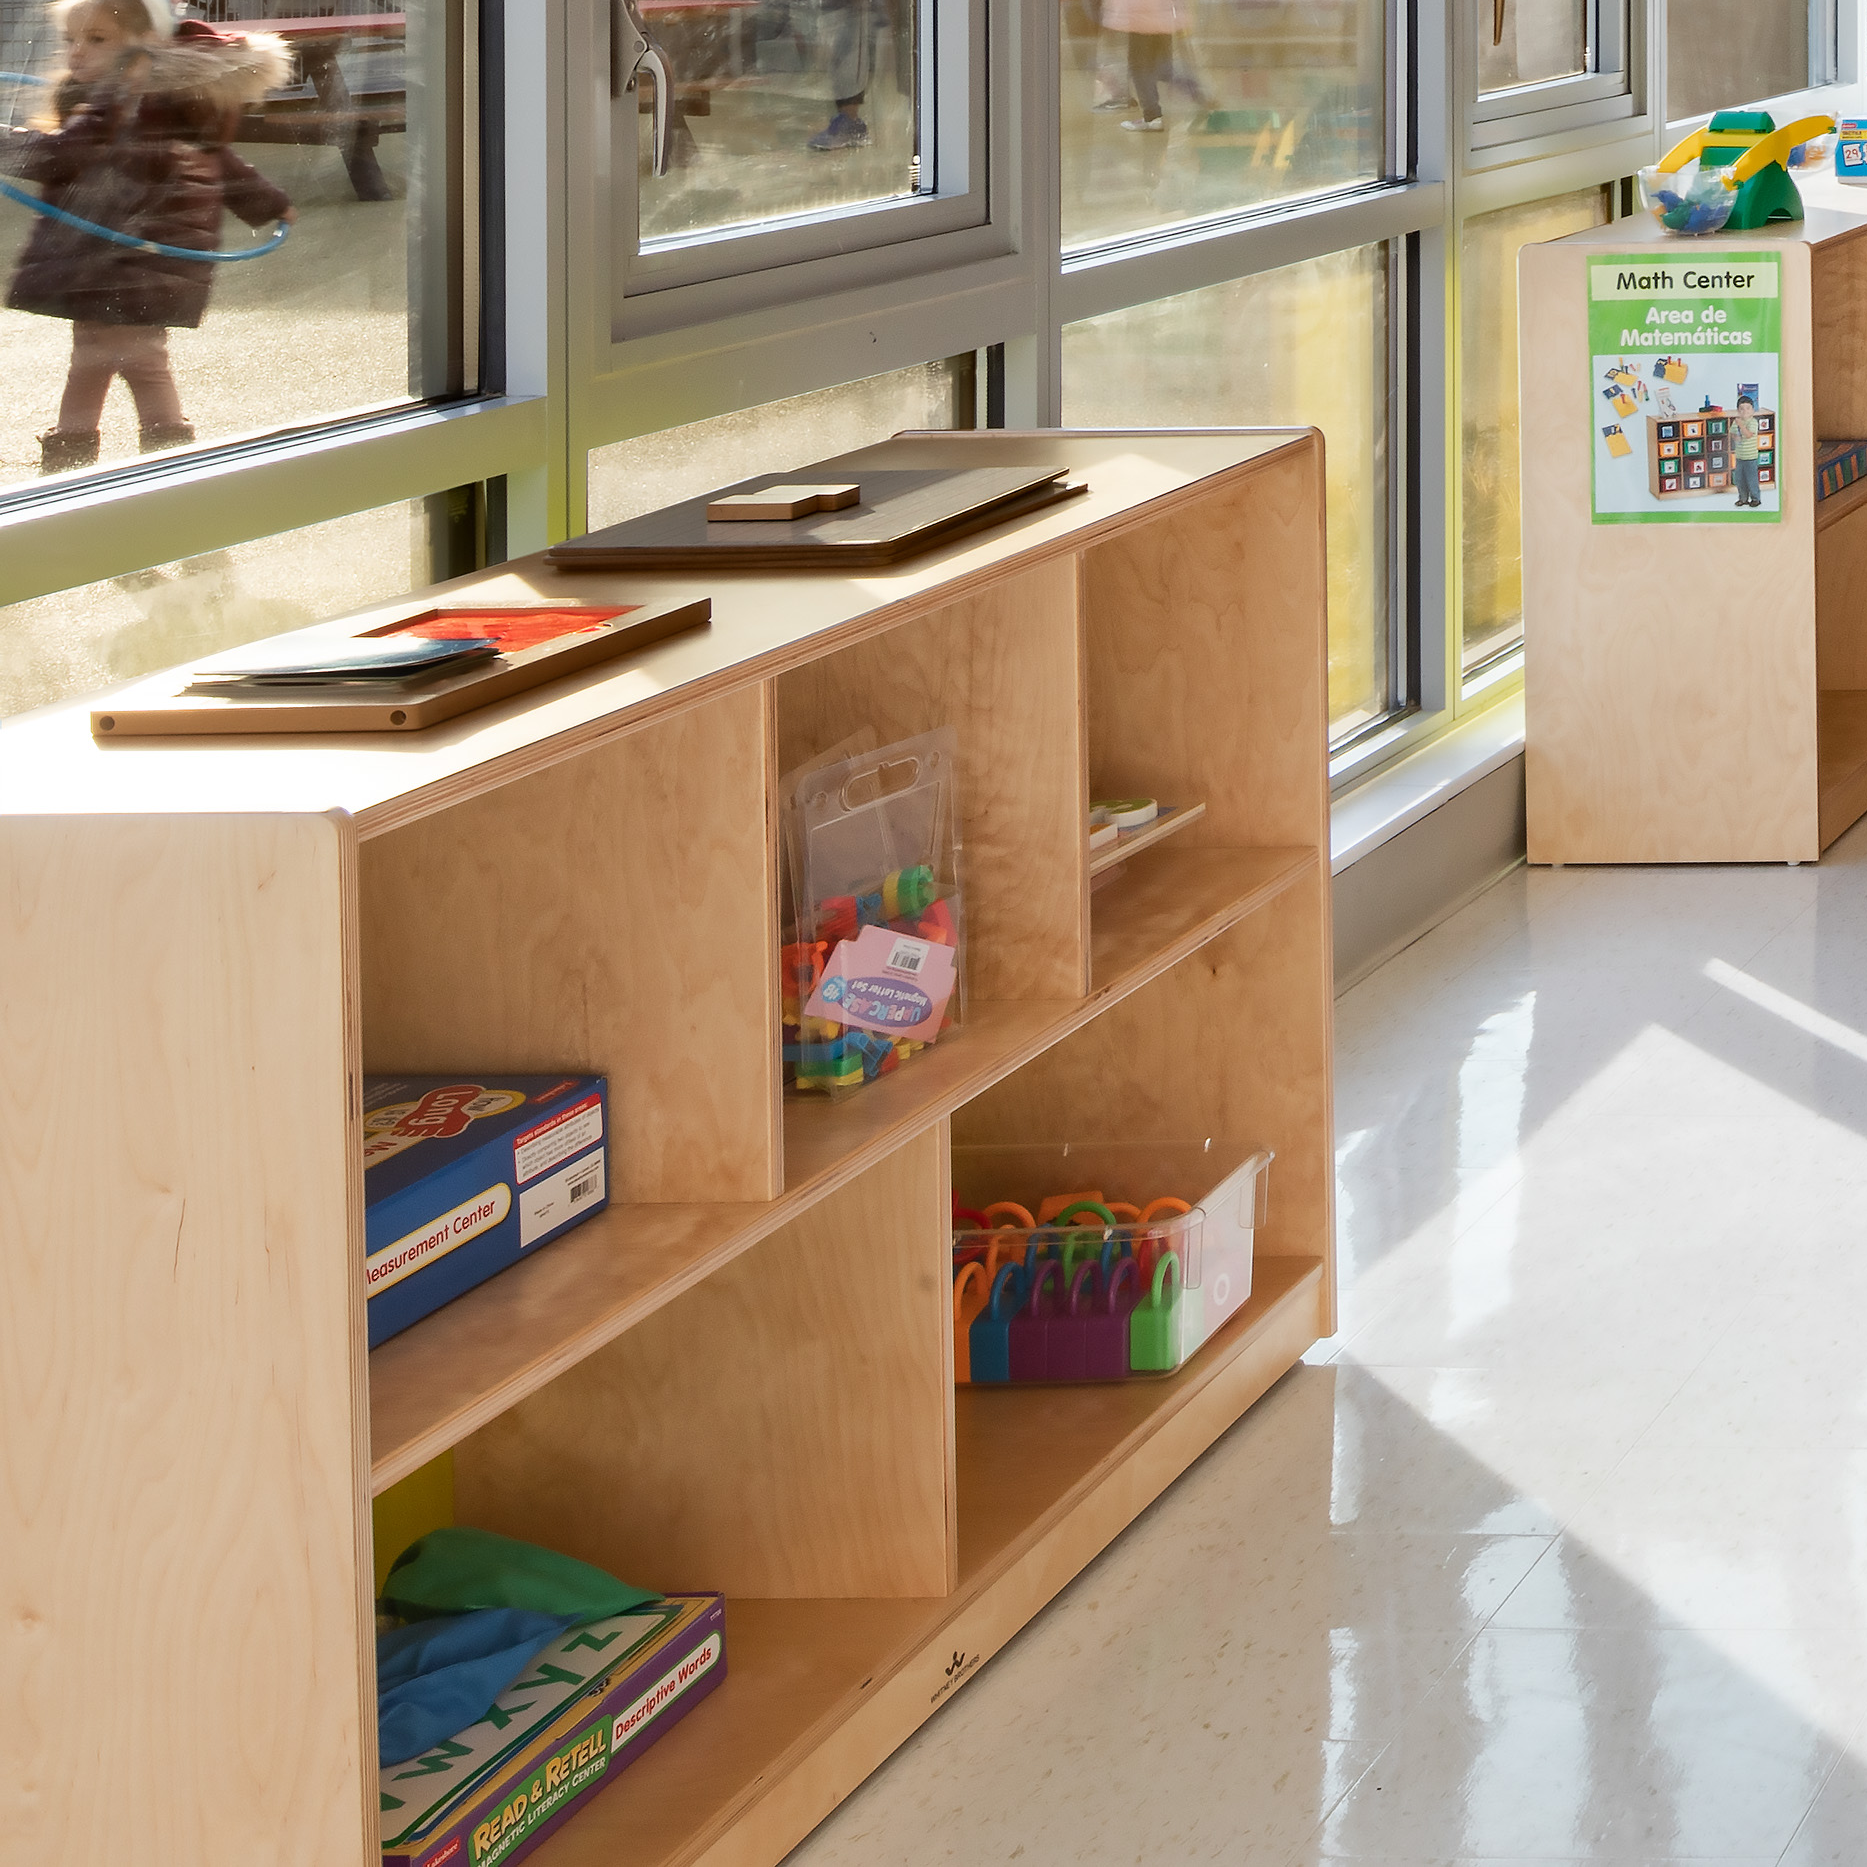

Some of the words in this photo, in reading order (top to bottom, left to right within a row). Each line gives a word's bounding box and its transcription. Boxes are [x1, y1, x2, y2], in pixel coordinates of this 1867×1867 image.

[1845, 148, 1859, 160] 29
[1616, 271, 1673, 290] Math
[1683, 271, 1755, 289] Center
[1645, 306, 1694, 324] Area
[1701, 305, 1727, 323] de
[1620, 326, 1752, 347] Matemáticas
[822, 983, 840, 1000] 48
[851, 980, 869, 992] Set
[868, 984, 895, 999] Letter
[842, 993, 921, 1022] UPPERCASE
[894, 989, 929, 1007] Magnetic
[408, 1090, 474, 1126] Long
[367, 1224, 450, 1285] easurement
[453, 1200, 496, 1234] Center
[510, 1662, 587, 1692] Y
[560, 1631, 623, 1653] Z
[615, 1679, 676, 1740] Descriptive
[677, 1646, 712, 1684] Words
[473, 1794, 529, 1861] READ
[530, 1779, 544, 1804] &
[545, 1728, 607, 1793] RETELL
[527, 1782, 570, 1826] LITERACY
[571, 1756, 607, 1787] CENTER
